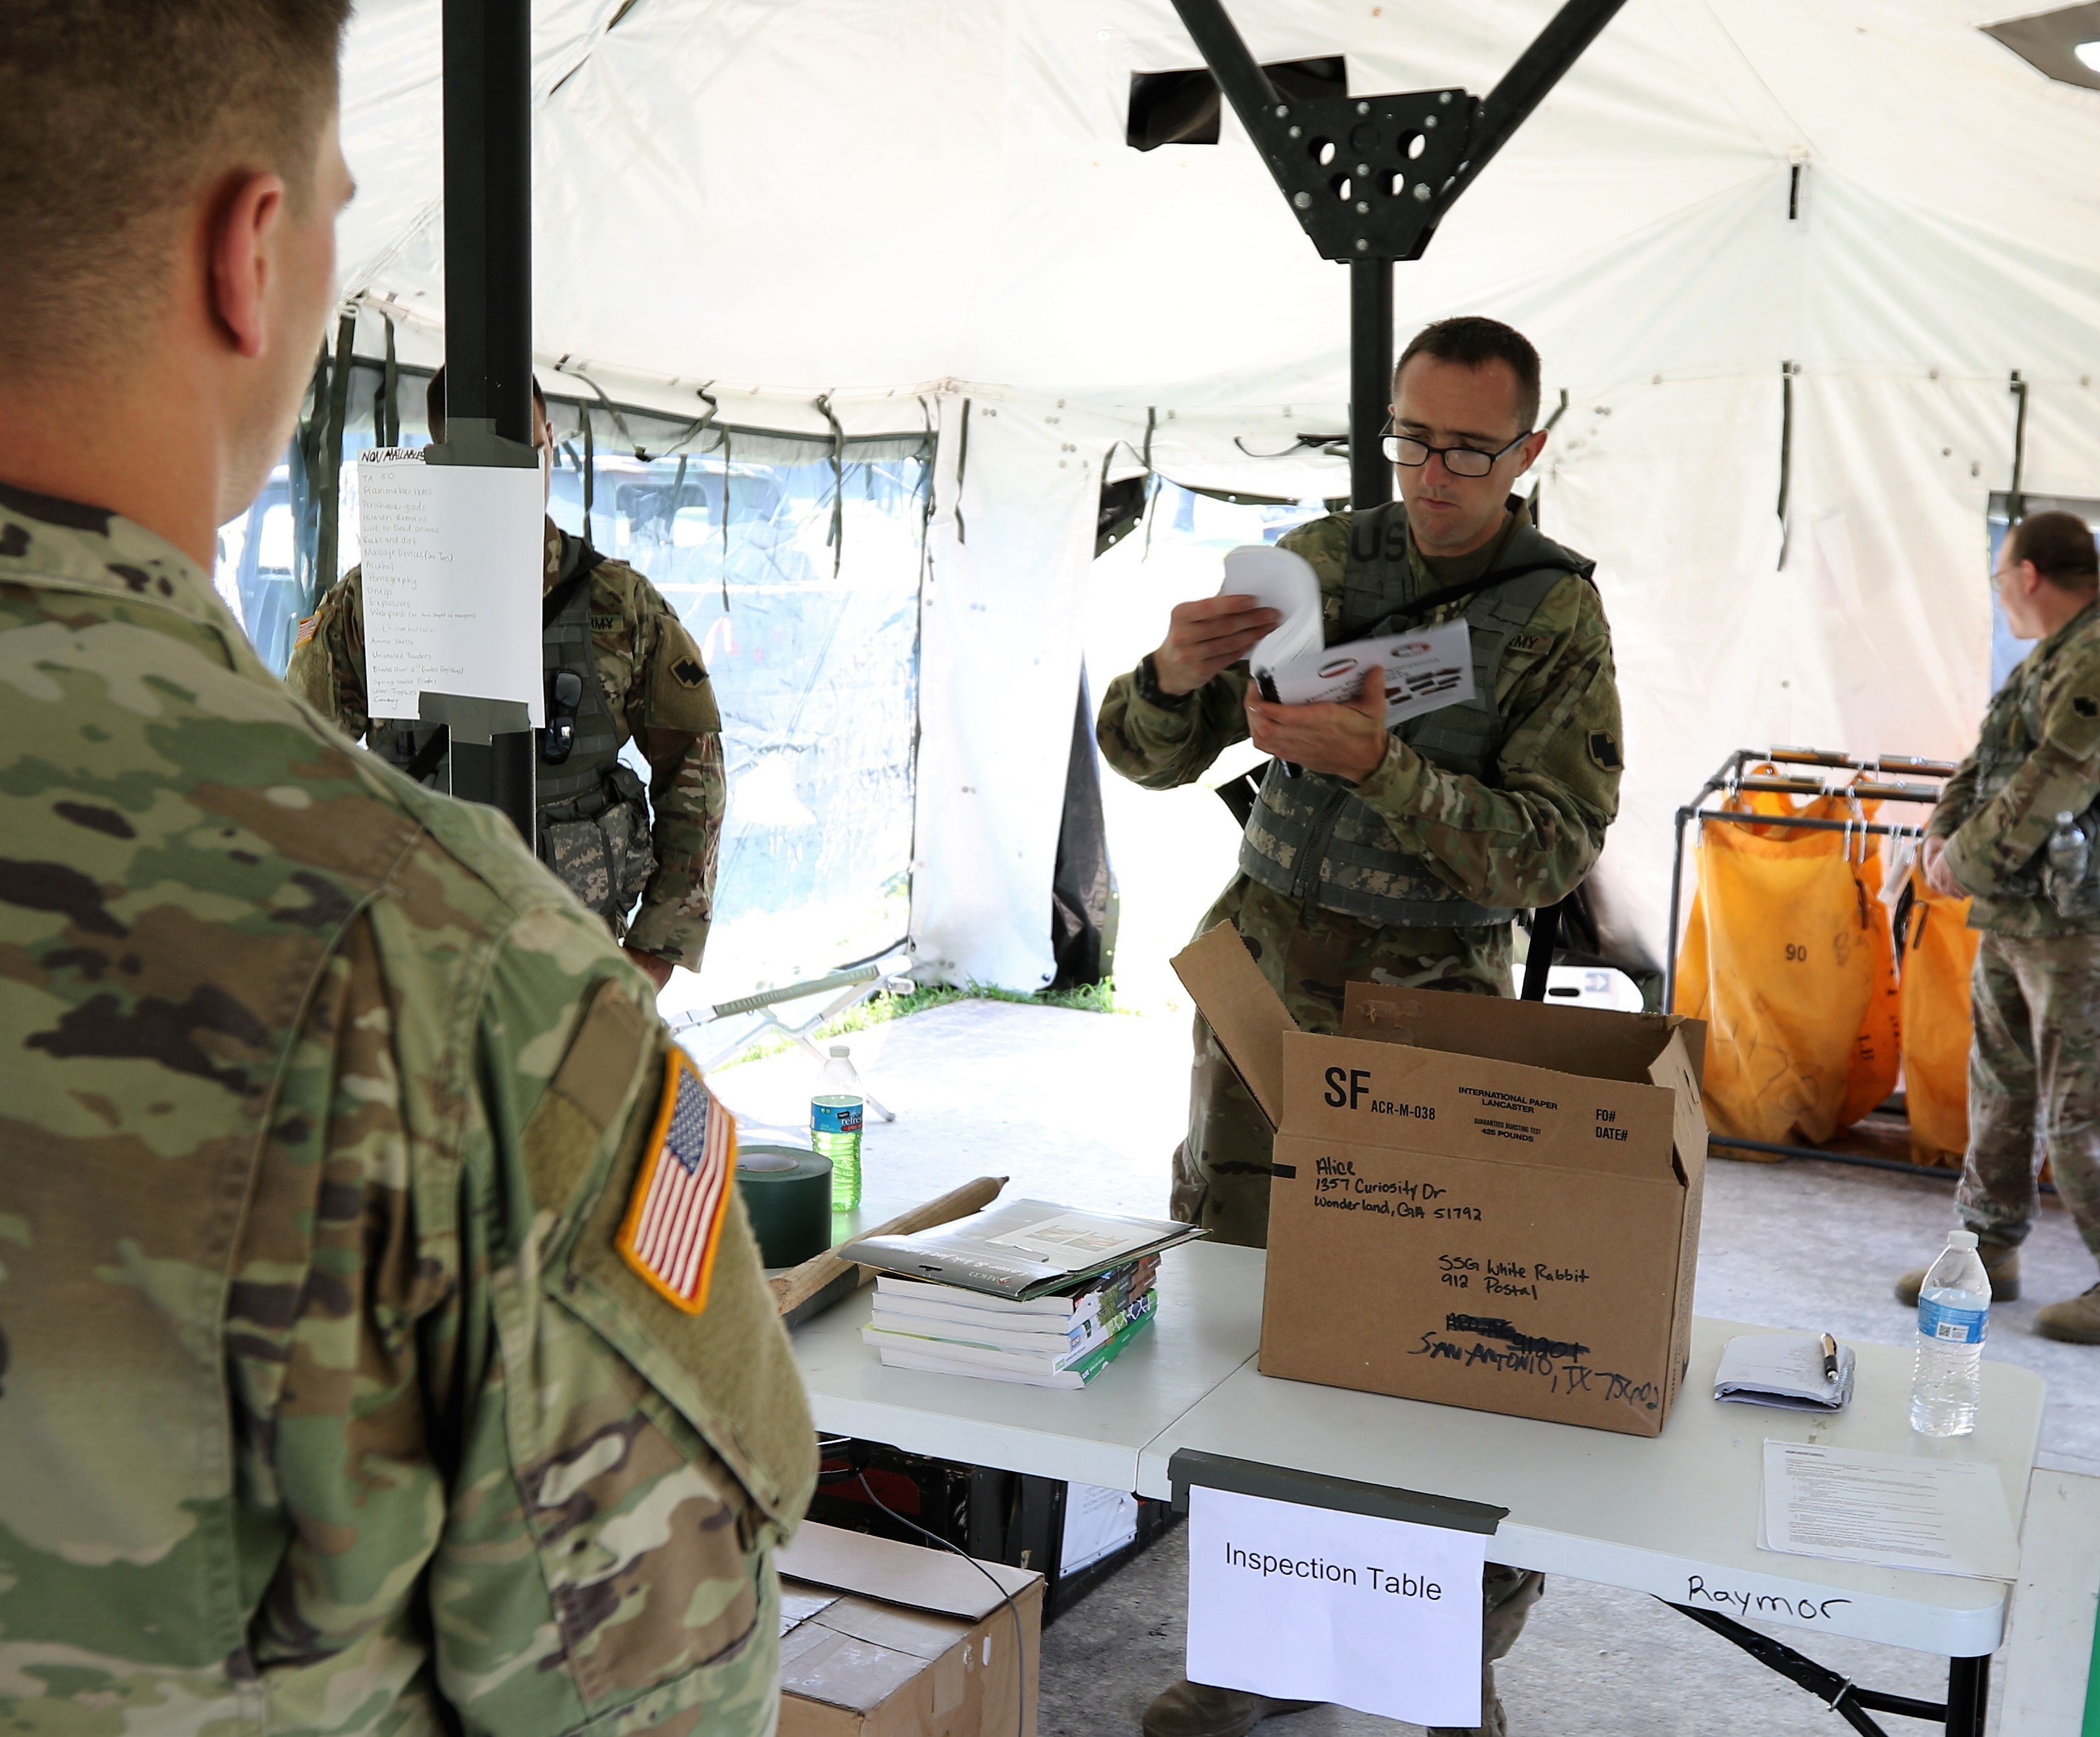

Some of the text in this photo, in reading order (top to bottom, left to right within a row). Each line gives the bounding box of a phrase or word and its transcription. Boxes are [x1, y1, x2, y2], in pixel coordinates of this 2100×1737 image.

[1351, 520, 1407, 562] US
[591, 617, 613, 629] MY
[1785, 943, 1807, 962] 90
[1324, 1066, 1436, 1120] SF ACR-M-038
[1459, 1086, 1557, 1110] INTERNATIONAL PAPER
[1482, 1099, 1535, 1114] LANCASTER
[1474, 1117, 1504, 1129] GUARANTEED
[1596, 1126, 1628, 1141] DATE#
[1481, 1128, 1534, 1142] 425 POUNDS
[1316, 1156, 1356, 1176] Alice
[1316, 1177, 1447, 1200] 1357 Curiosity Dr
[1434, 1208, 1481, 1221] 51792
[1439, 1254, 1590, 1283] SSG White Rabbit
[1441, 1273, 1538, 1301] 912 Postal
[1562, 1365, 1593, 1395] TX
[1227, 1541, 1442, 1601] Inspection Table
[1688, 1575, 1853, 1620] Raymor
